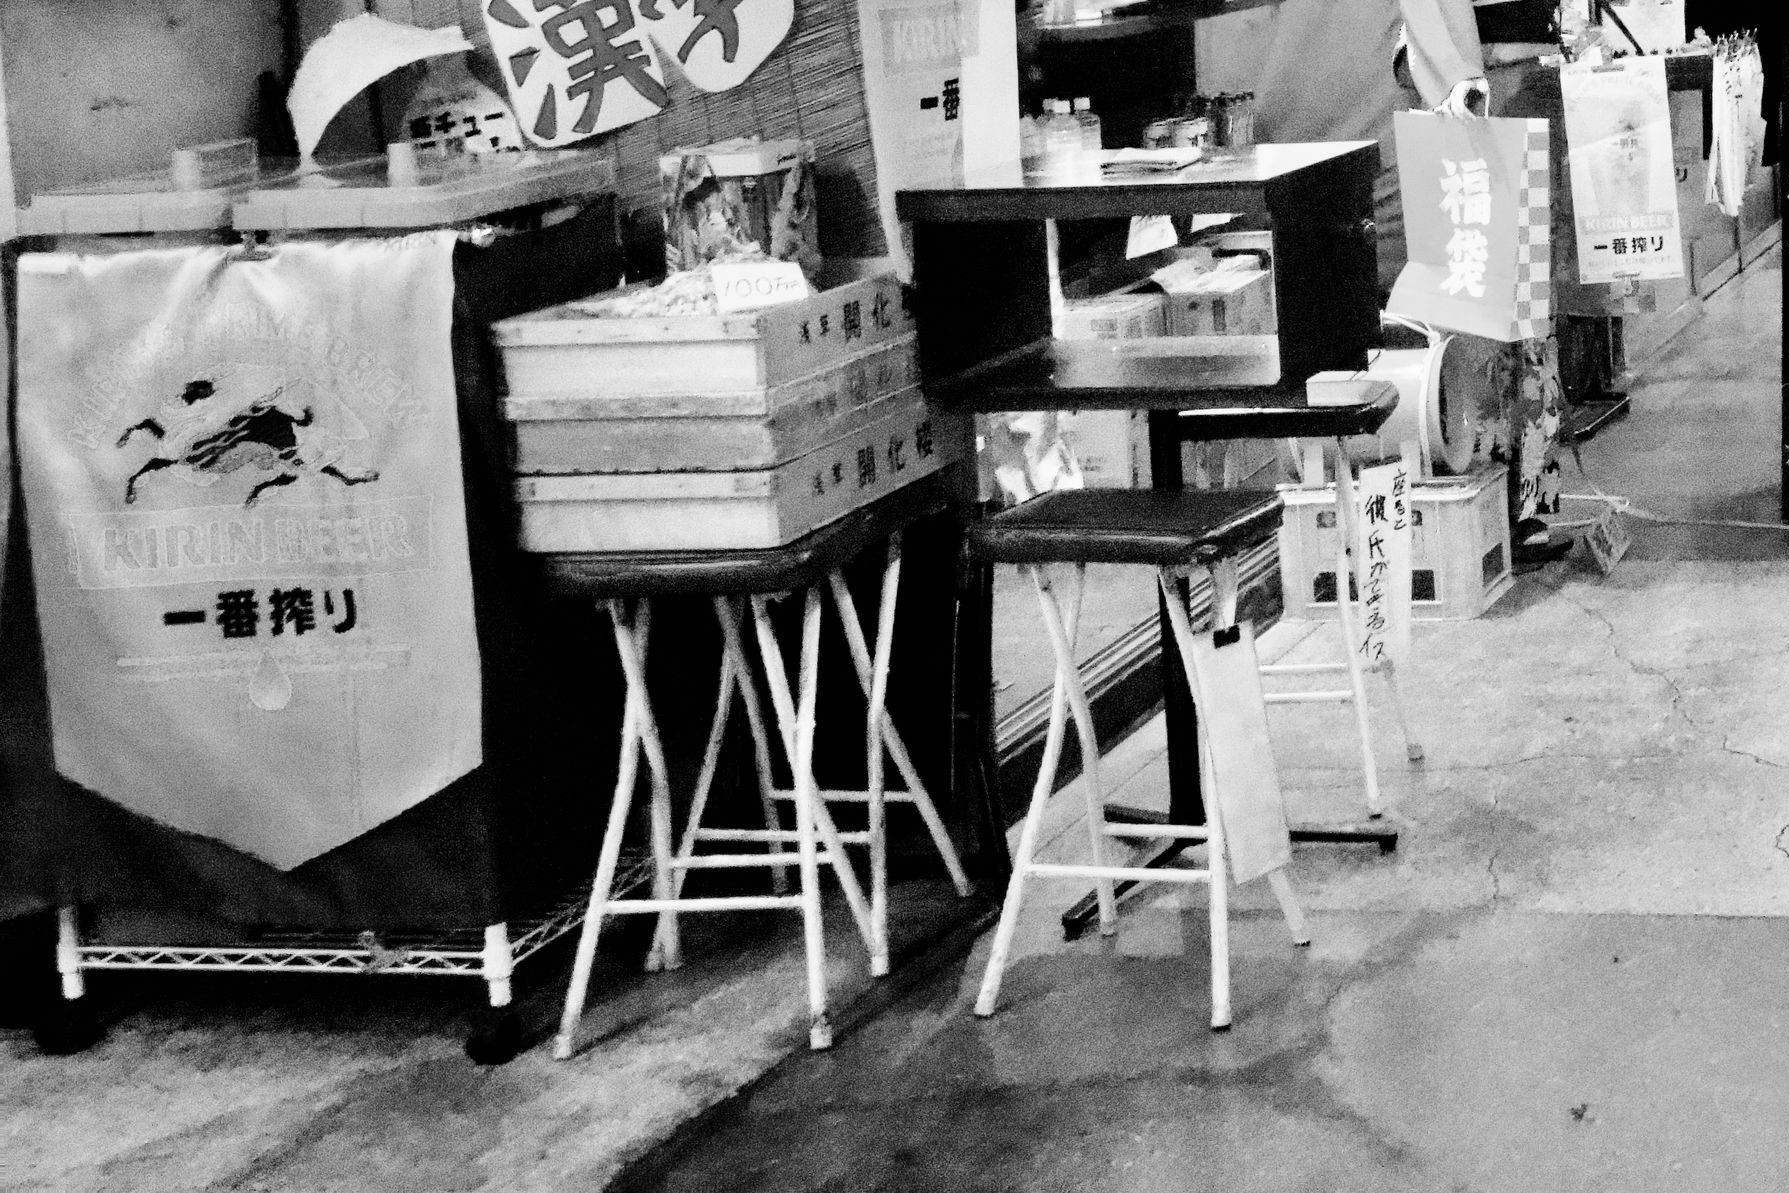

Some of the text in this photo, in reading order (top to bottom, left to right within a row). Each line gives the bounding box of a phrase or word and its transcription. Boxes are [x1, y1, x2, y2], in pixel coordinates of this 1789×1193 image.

[1439, 158, 1492, 298] 福袋
[1594, 236, 1664, 255] 一番搾り
[103, 514, 416, 573] KIRIN BEER
[163, 588, 358, 639] 一番搾り
